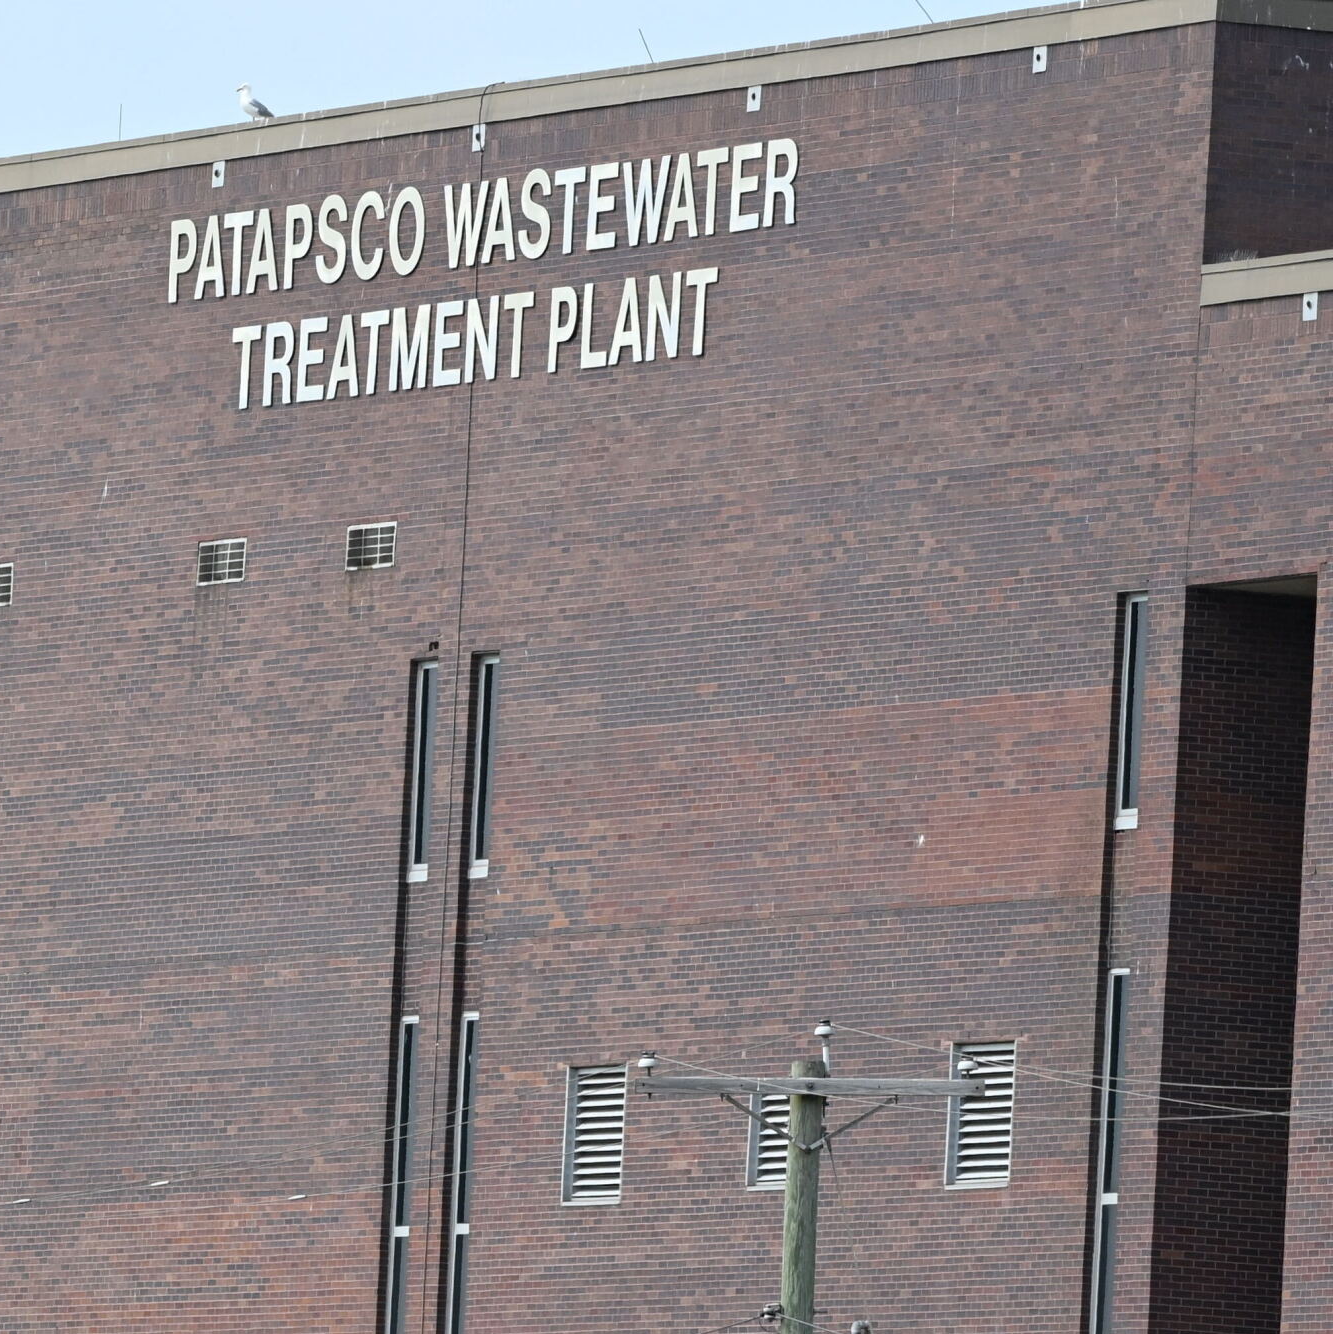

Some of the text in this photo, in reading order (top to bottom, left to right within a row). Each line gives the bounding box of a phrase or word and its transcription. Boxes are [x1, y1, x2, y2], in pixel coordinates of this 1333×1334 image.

[167, 138, 799, 304] PATAPSCO WASTEWATER
[232, 267, 719, 410] TREATMENT PLANT
